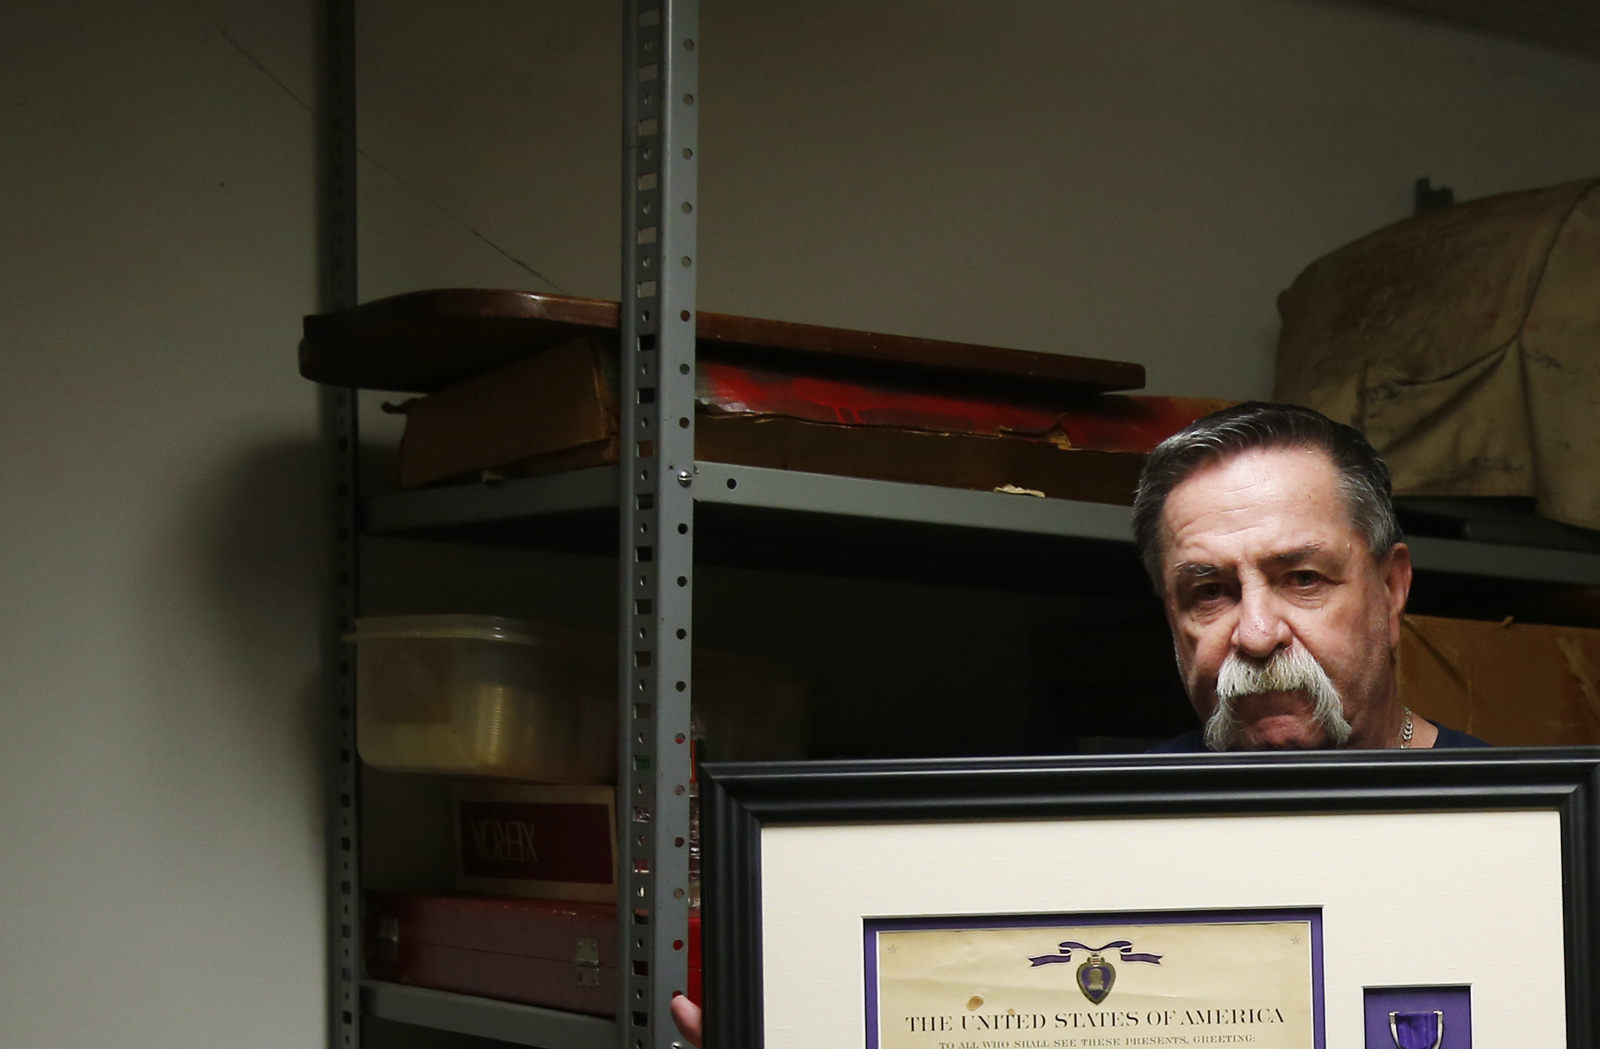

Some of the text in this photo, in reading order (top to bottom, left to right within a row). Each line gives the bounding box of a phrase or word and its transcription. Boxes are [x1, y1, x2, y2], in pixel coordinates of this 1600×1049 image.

[470, 820, 538, 863] XEROX
[905, 1008, 1285, 1032] THE UNITED STATES OF AMERICA
[1014, 1040, 1049, 1048] SHALL
[1081, 1038, 1120, 1046] THESE
